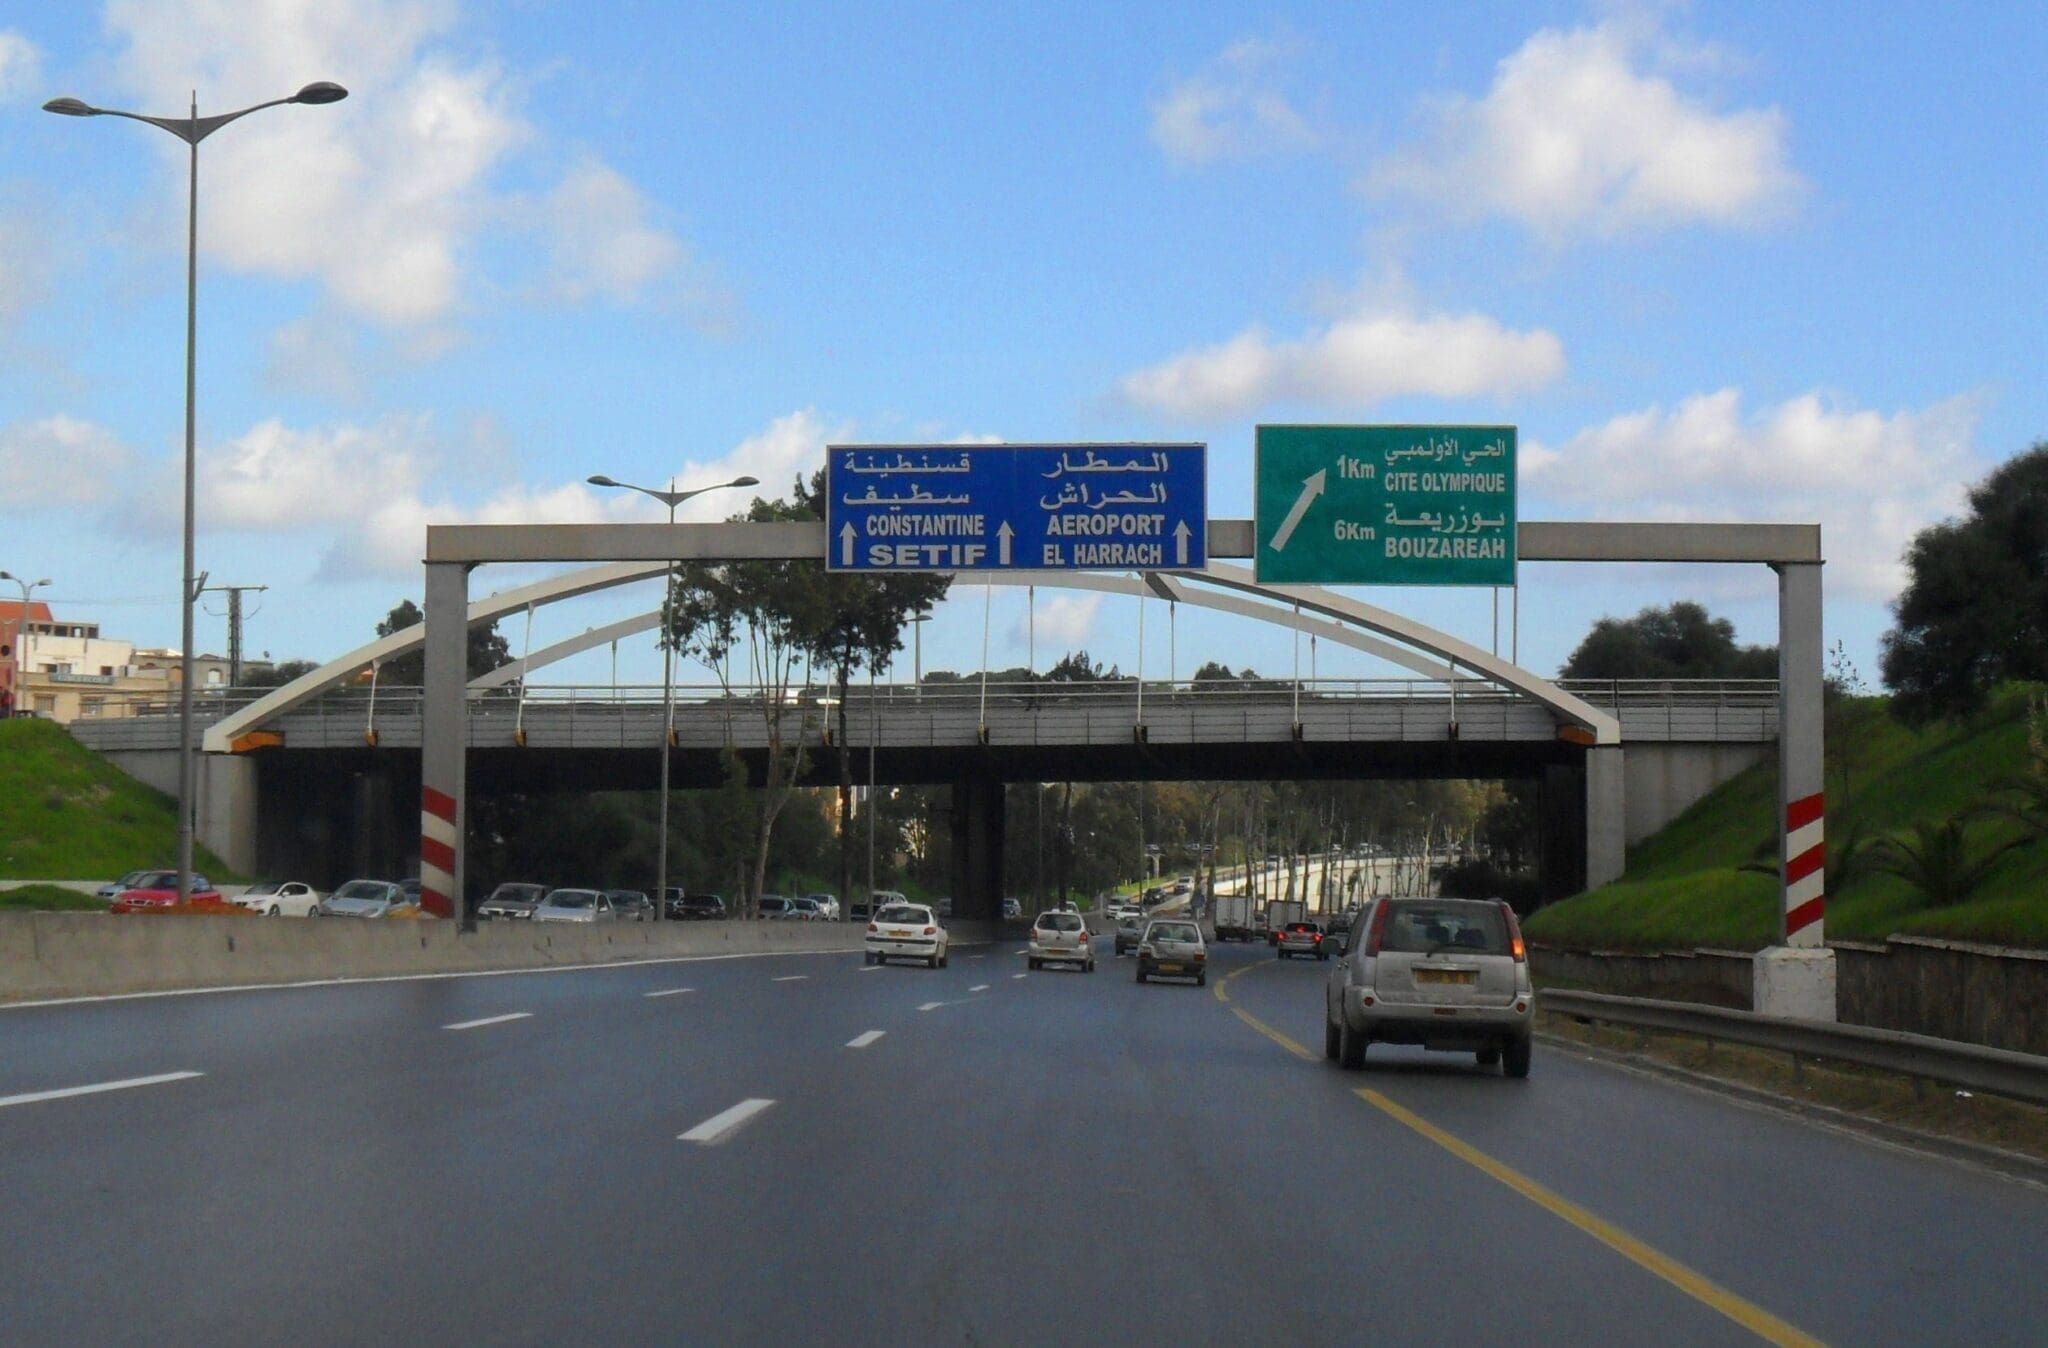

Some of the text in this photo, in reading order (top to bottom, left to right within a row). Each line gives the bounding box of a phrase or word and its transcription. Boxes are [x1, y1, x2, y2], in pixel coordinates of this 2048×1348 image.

[1462, 438, 1506, 468] الحي
[843, 452, 970, 479] قسنطينة
[1041, 451, 1168, 479] المطار
[1336, 455, 1375, 479] 1Km
[1385, 473, 1505, 493] CITE OLYMPIQUE
[843, 483, 970, 511] سطيف
[1039, 482, 1168, 510] الحراش
[866, 514, 985, 537] CONSTANTINE
[1046, 514, 1165, 536] AEROPORT
[1384, 502, 1506, 534] بوزريعة
[1334, 520, 1376, 541] 6Km
[868, 544, 987, 566] SETIF
[1043, 544, 1162, 565] EL HARRACH
[1385, 538, 1506, 559] BOUZAREAH
